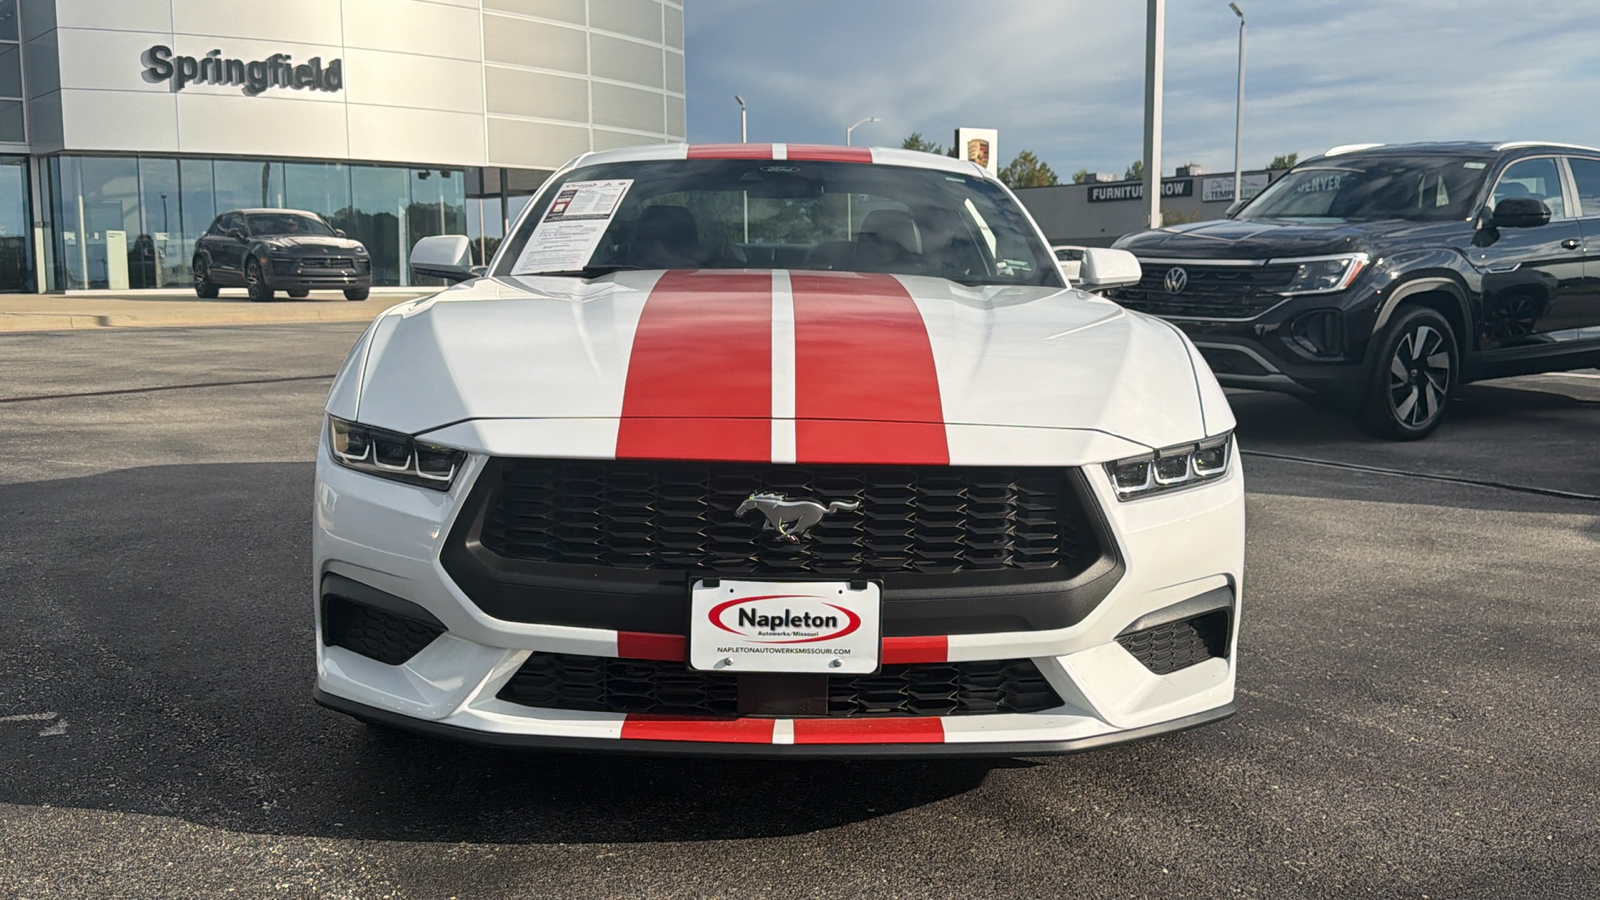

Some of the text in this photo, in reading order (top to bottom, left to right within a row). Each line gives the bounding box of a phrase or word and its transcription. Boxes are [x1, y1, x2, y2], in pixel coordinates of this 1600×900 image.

[142, 45, 342, 96] Springfield
[1092, 185, 1143, 200] FURNITU
[738, 607, 838, 631] Napleton
[757, 630, 819, 638] Autowerks/Missouri
[717, 646, 851, 655] NAPLETONAUTOWERKSMISSOURI.COM
